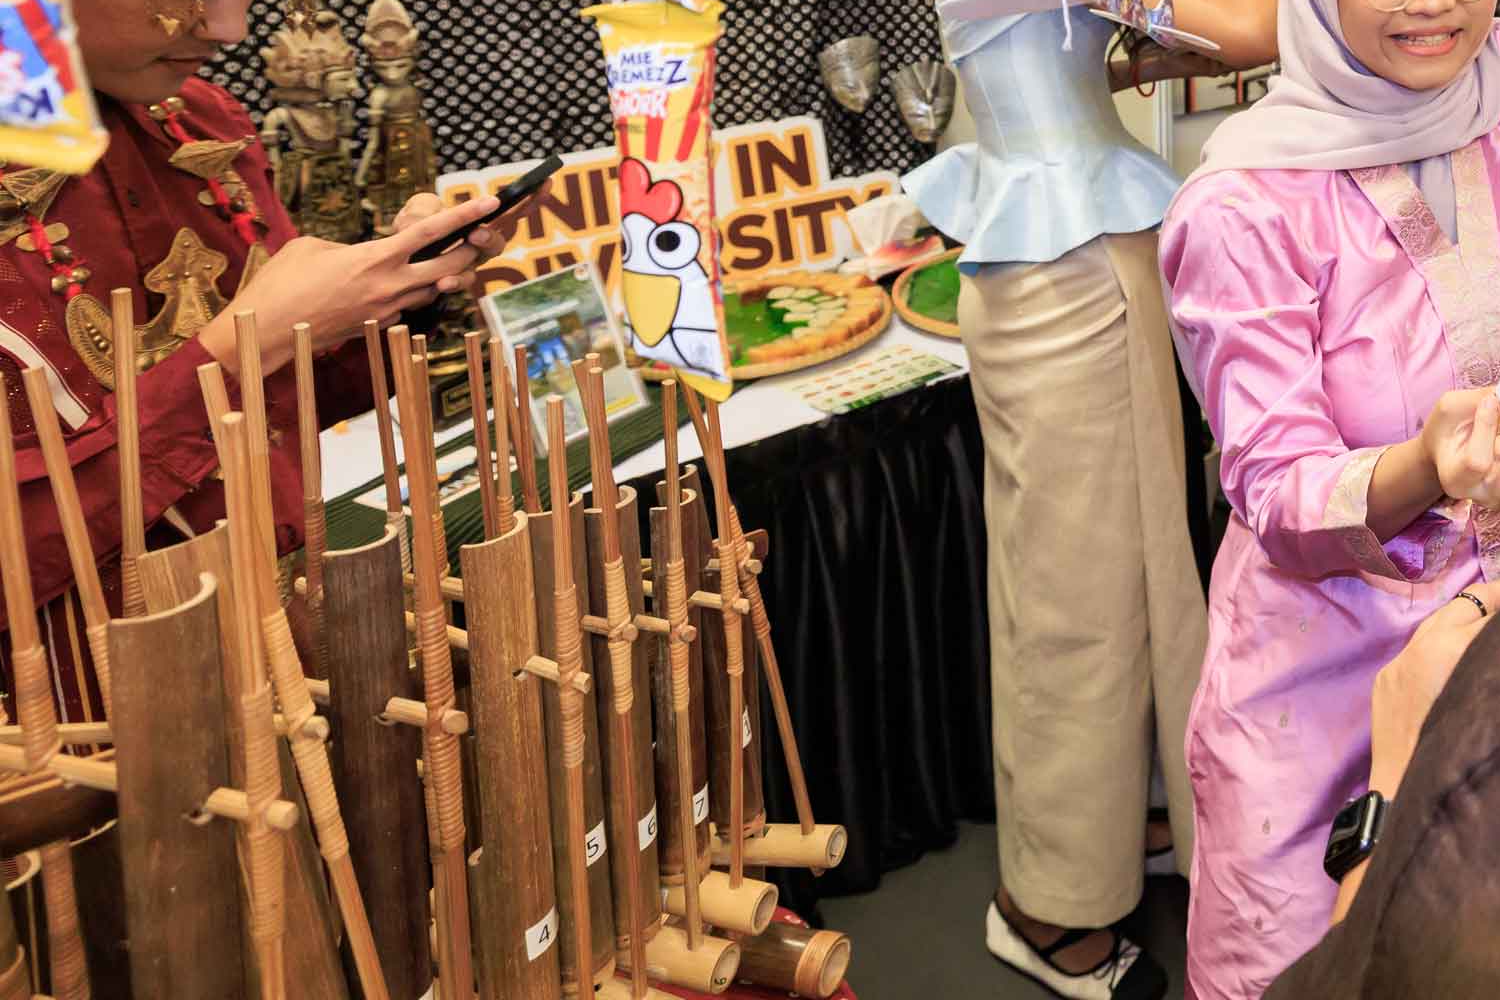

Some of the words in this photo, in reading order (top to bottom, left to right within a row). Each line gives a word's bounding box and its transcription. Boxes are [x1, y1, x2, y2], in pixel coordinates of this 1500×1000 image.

[735, 134, 812, 199] IN
[696, 797, 705, 817] 7
[647, 816, 656, 836] 6
[587, 836, 599, 858] 5
[539, 925, 551, 943] 4
